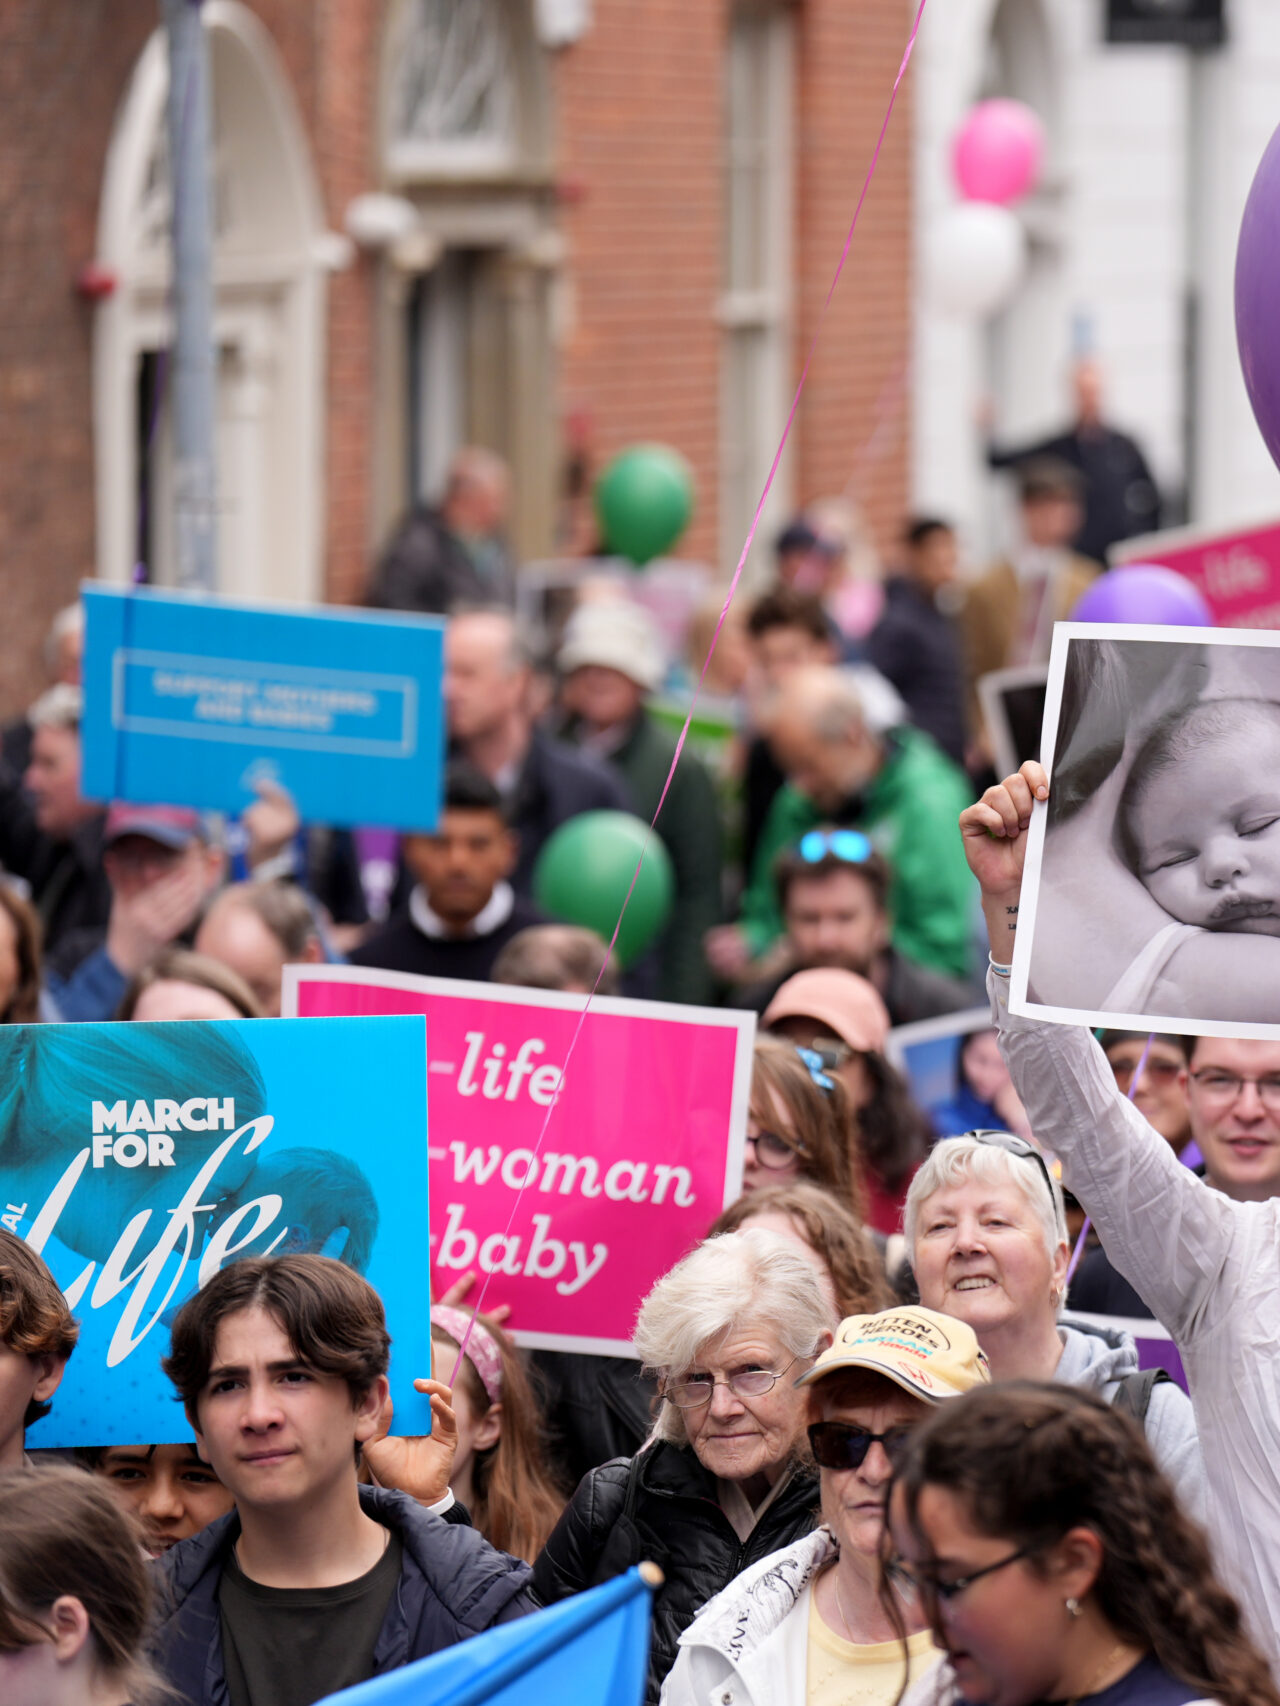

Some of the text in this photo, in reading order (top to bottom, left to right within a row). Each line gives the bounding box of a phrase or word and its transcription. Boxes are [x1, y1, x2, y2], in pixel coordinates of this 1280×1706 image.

[92, 1097, 235, 1133] MARCH
[92, 1134, 176, 1168] FOR
[429, 1203, 608, 1296] baby
[863, 1324, 940, 1349] HEROES
